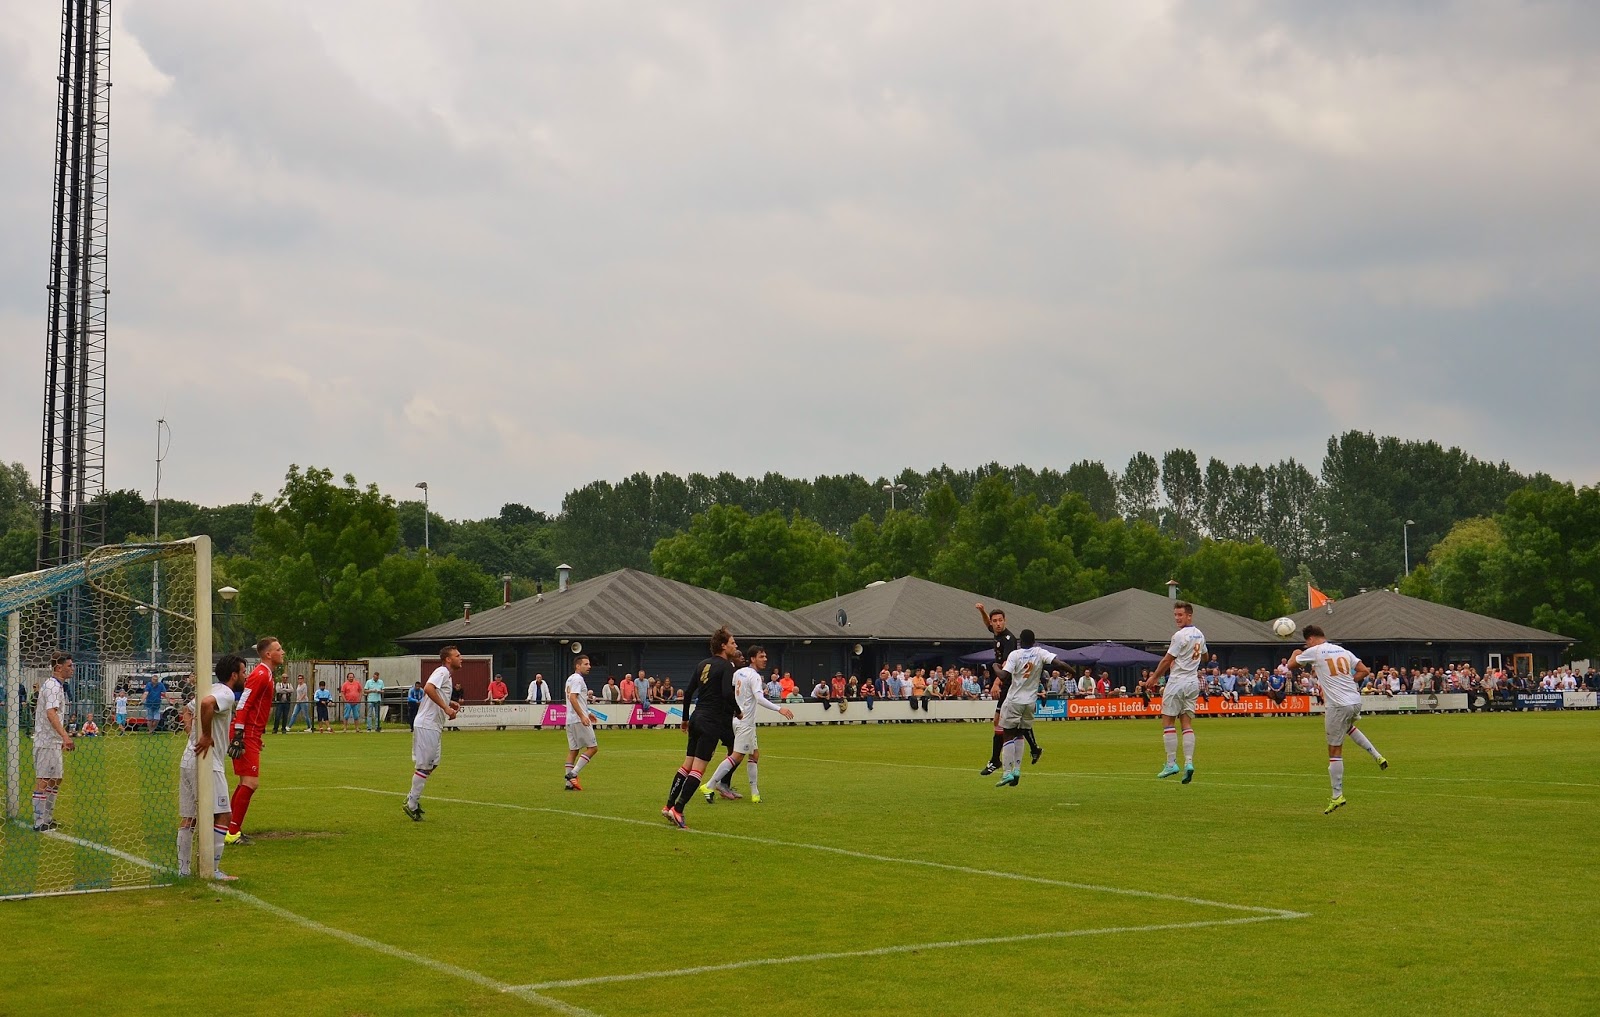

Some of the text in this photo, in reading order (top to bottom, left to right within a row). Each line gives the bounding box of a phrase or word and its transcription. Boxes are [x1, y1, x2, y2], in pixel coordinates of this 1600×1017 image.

[1191, 642, 1201, 661] 8
[700, 663, 712, 684] 4
[1022, 661, 1034, 679] 2
[1324, 656, 1350, 677] 10
[1069, 703, 1106, 716] Oranje
[1107, 702, 1117, 713] is
[1119, 701, 1148, 713] liefde
[1220, 700, 1253, 712] Oranje
[1254, 699, 1264, 710] is
